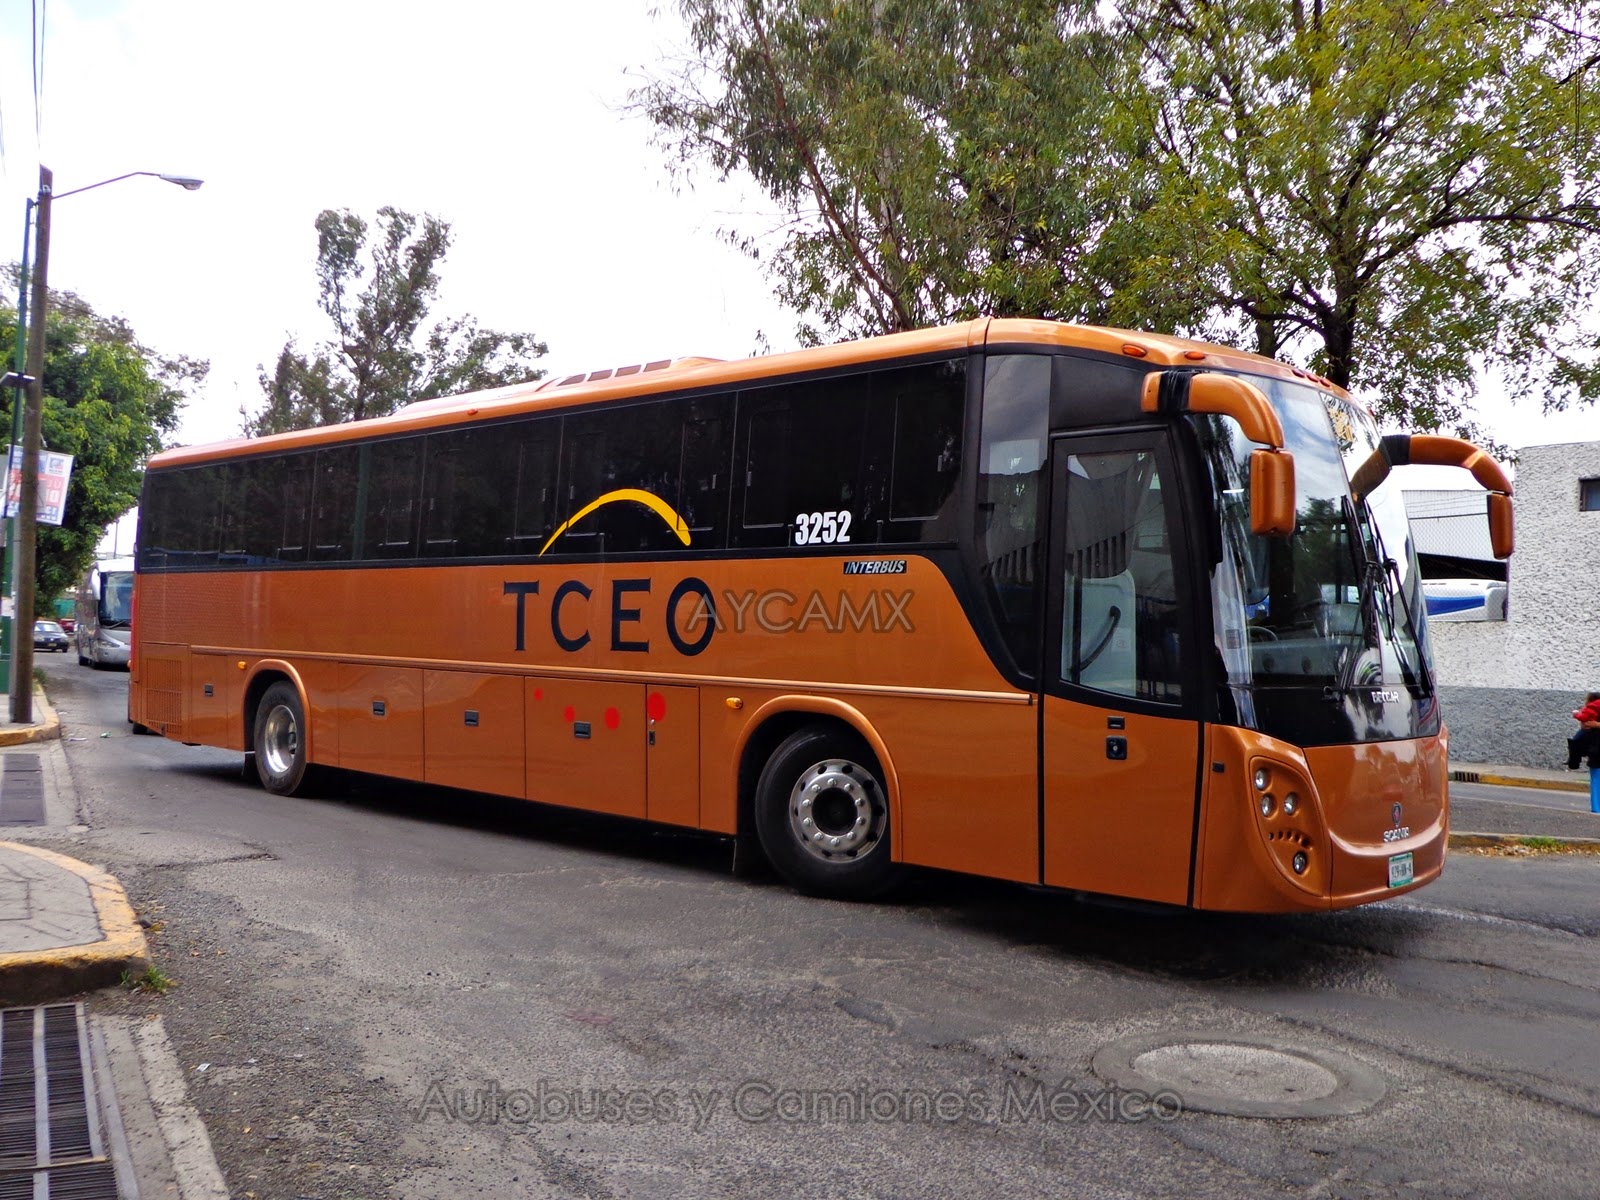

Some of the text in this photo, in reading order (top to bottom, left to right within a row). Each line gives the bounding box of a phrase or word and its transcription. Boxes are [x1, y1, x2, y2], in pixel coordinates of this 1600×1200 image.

[794, 510, 852, 546] 3252
[844, 560, 906, 575] INTERBUS
[502, 576, 717, 657] TCEO
